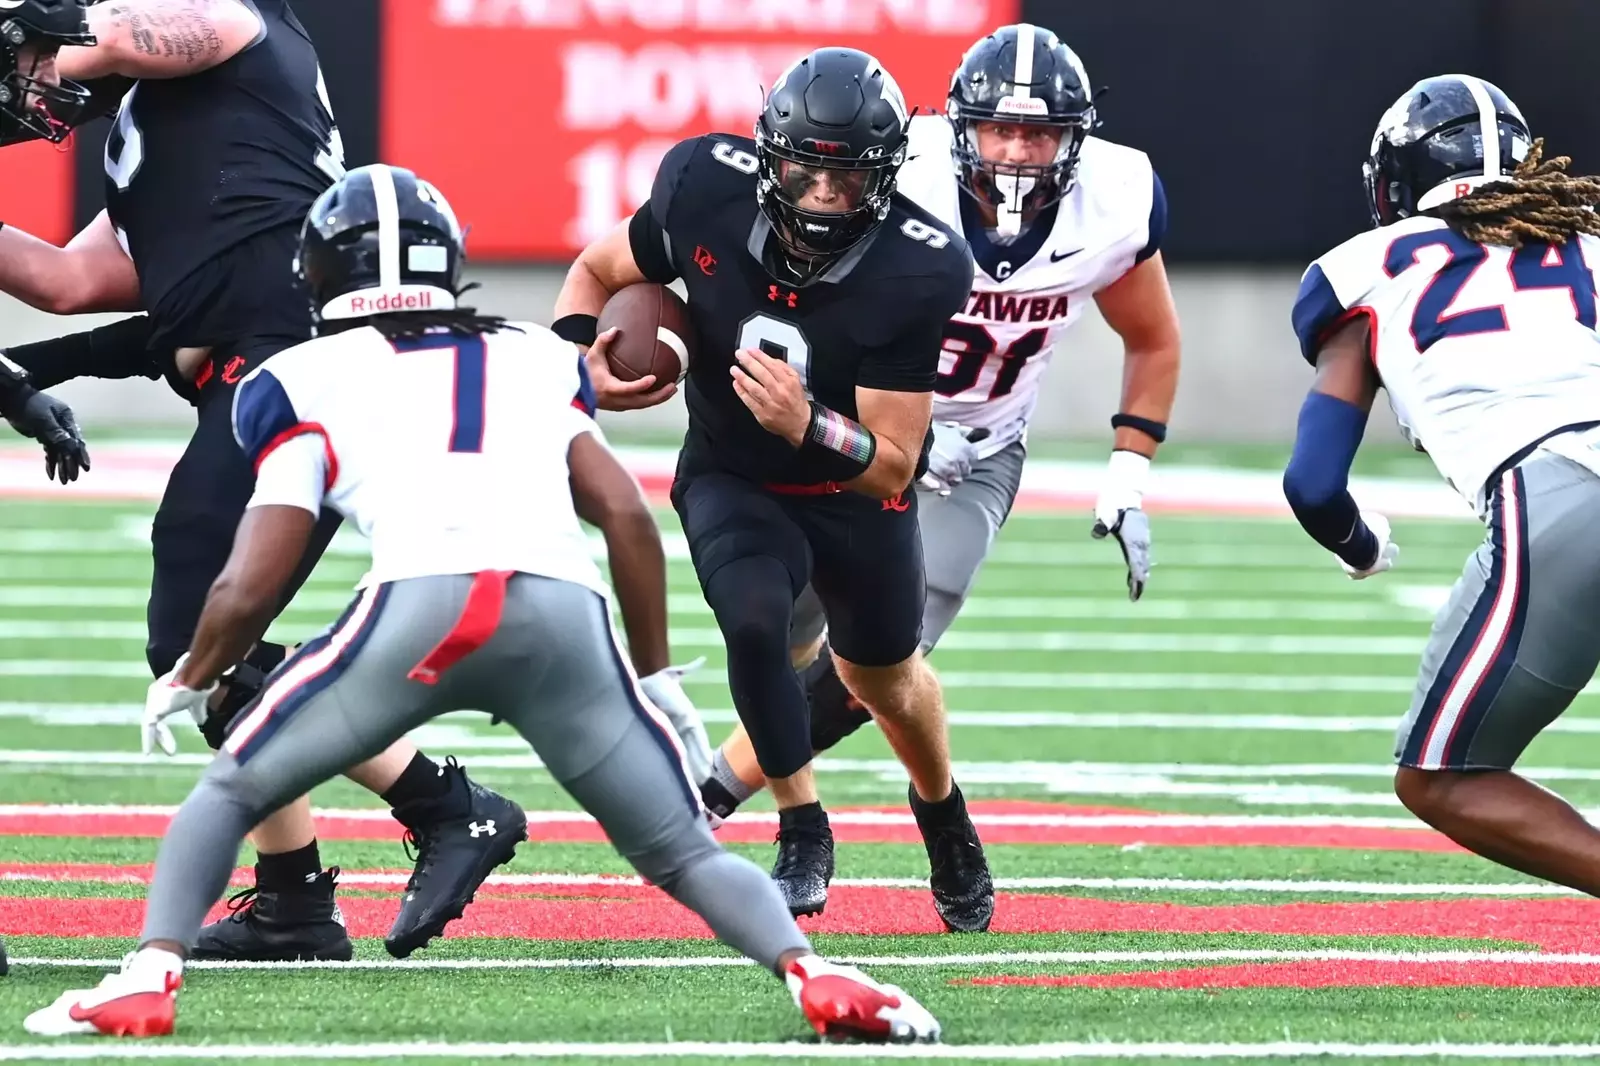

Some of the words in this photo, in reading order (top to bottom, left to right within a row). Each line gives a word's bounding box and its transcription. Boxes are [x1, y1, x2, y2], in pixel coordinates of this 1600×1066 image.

[711, 141, 760, 175] 9
[899, 217, 951, 249] 9
[351, 291, 432, 312] Riddell
[1381, 227, 1599, 355] 24
[384, 325, 488, 453] 7
